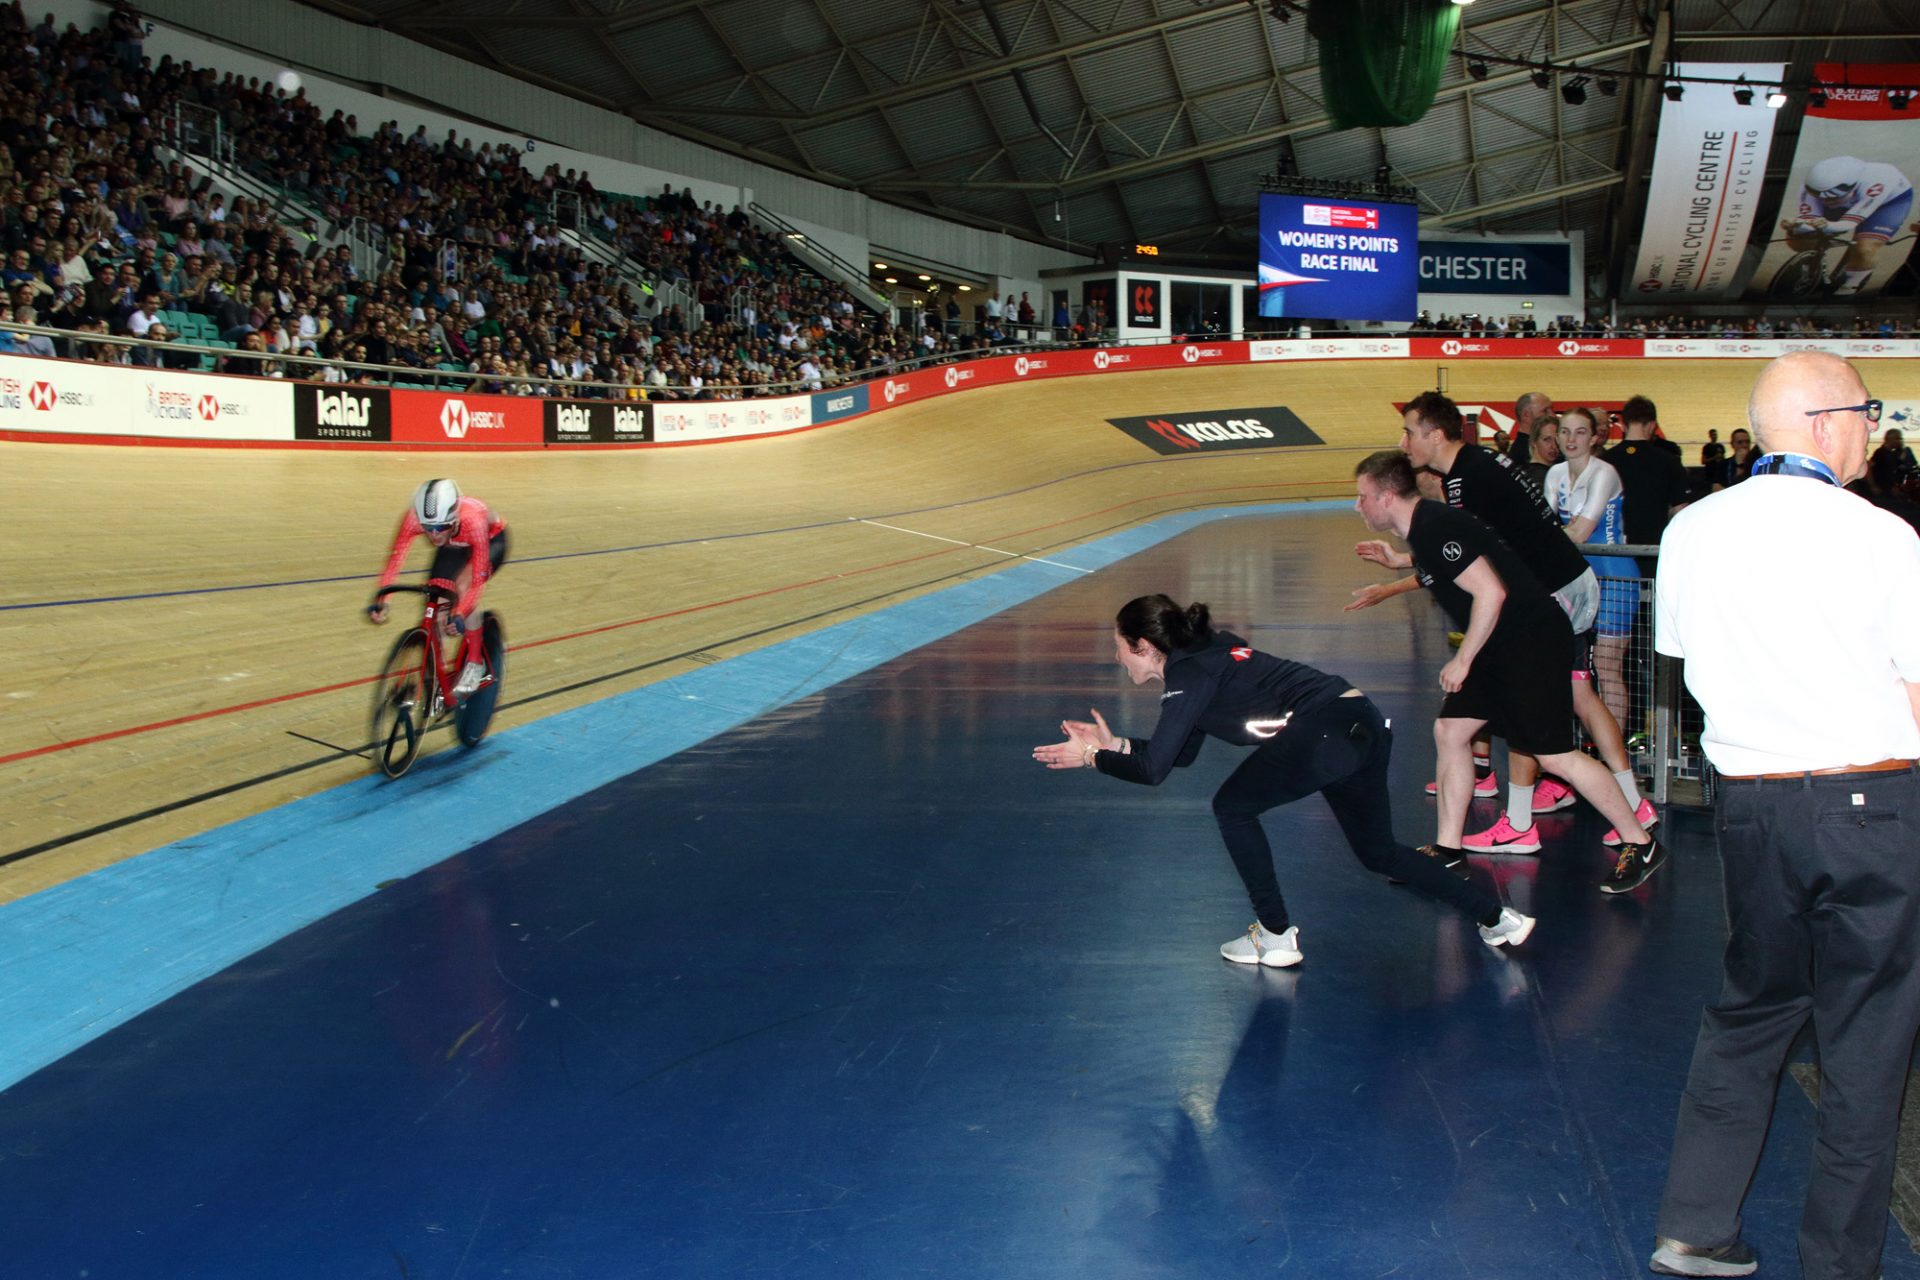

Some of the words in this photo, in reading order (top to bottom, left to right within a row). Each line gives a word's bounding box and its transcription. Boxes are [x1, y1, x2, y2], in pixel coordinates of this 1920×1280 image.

[1835, 93, 1879, 101] CYCLING
[526, 140, 535, 153] G
[1695, 131, 1724, 191] CENTRE
[1714, 257, 1727, 267] OF
[1722, 203, 1743, 251] BRITISH
[1735, 131, 1758, 194] CYCLING
[1683, 197, 1711, 248] CYCLING
[1278, 230, 1347, 250] WOMEN'S
[1349, 235, 1399, 253] POINTS
[1301, 253, 1338, 270] RACE
[1341, 256, 1379, 272] FINAL
[1419, 255, 1527, 280] CHESTER
[1669, 251, 1698, 293] NATIONAL
[1462, 344, 1480, 352] HSBC
[59, 391, 83, 406] HSBC
[159, 391, 192, 406] BRITISH
[159, 405, 192, 419] CYCLING
[221, 403, 240, 415] HSBC
[470, 411, 493, 429] HSBC
[493, 412, 506, 429] UK
[317, 428, 372, 438] SPORTSWEAR
